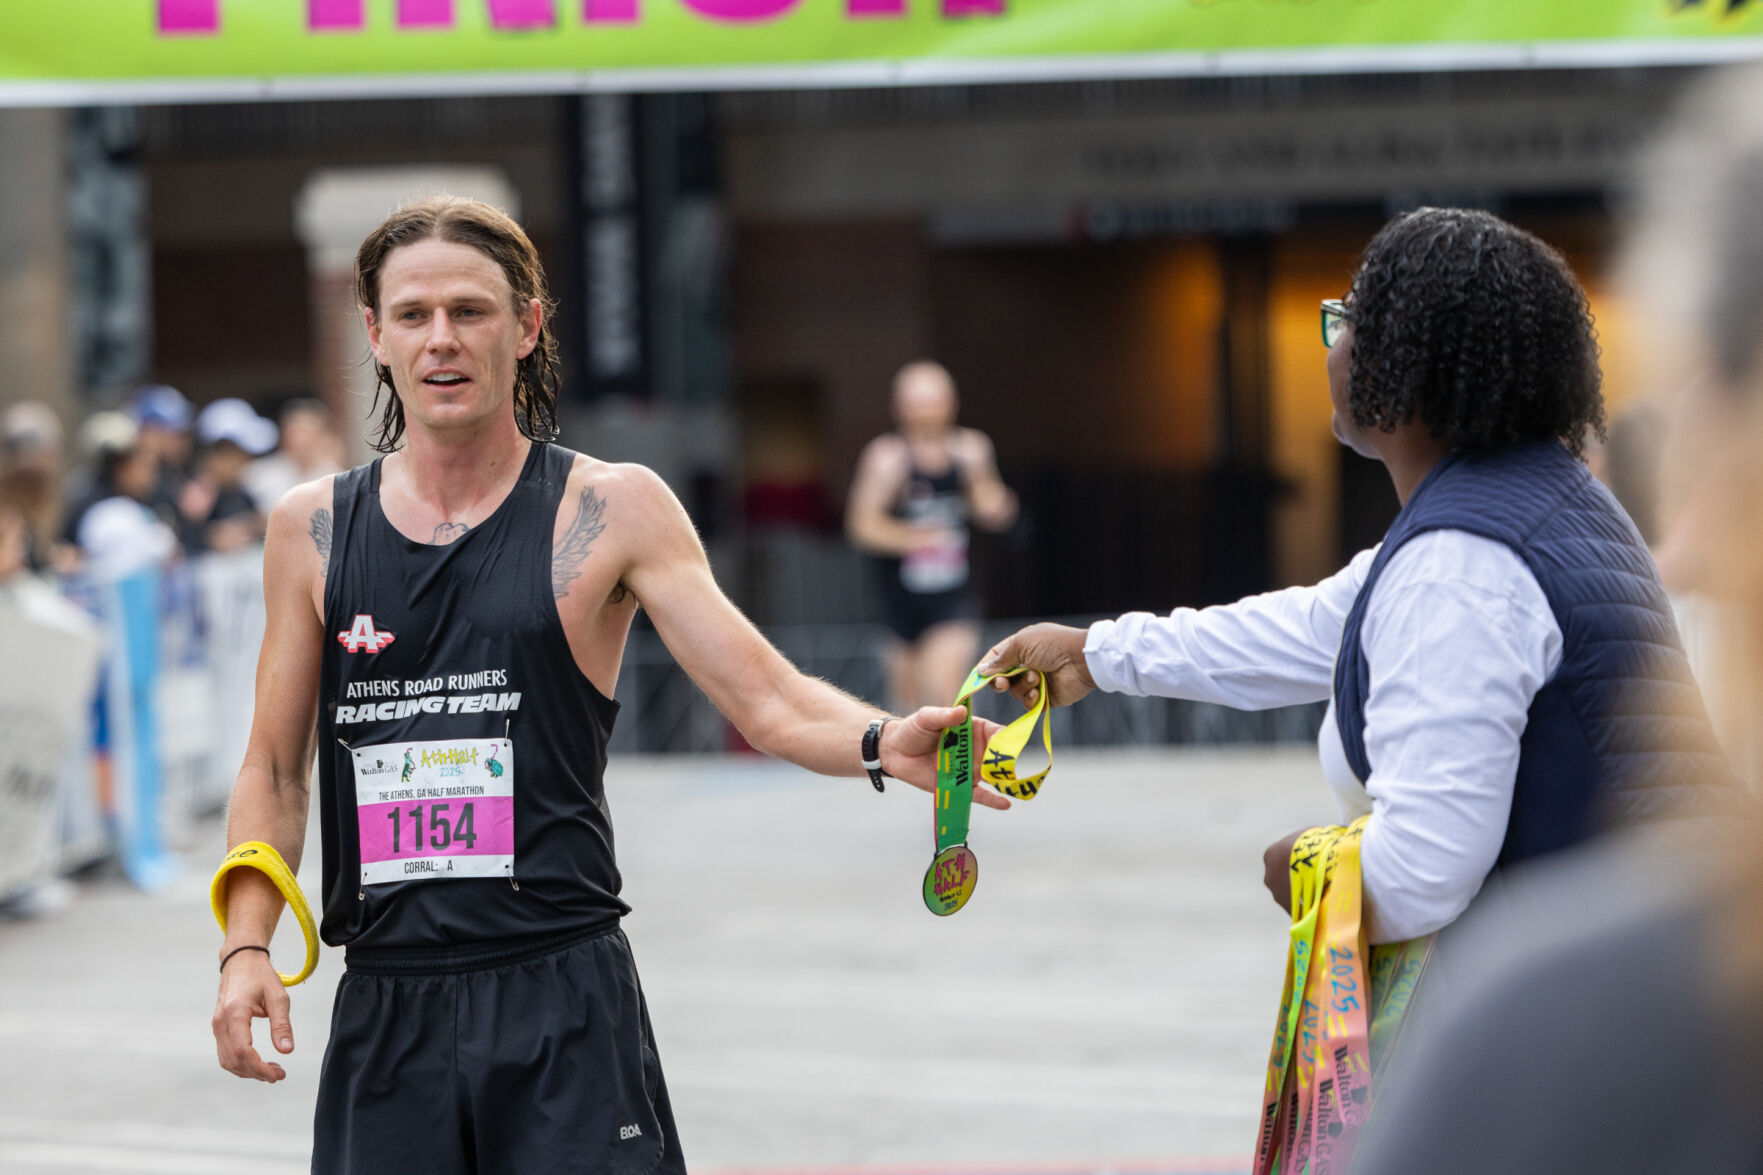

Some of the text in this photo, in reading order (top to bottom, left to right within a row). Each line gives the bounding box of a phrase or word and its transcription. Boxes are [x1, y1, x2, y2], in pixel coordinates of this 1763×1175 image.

[346, 669, 507, 699] ATHENS ROAD RUNNERS
[335, 692, 522, 724] RACING TEAM
[955, 728, 969, 787] Walton
[379, 785, 484, 800] THE ATHENS, GA HALF MARATHON
[388, 802, 477, 853] 1154
[404, 860, 454, 874] CORRAL: A
[935, 853, 966, 881] ATH
[933, 870, 970, 896] HALF
[1329, 946, 1361, 1012] 2025
[1334, 1045, 1352, 1108] Walton
[1317, 1078, 1334, 1140] Walton
[620, 1123, 643, 1140] BOA
